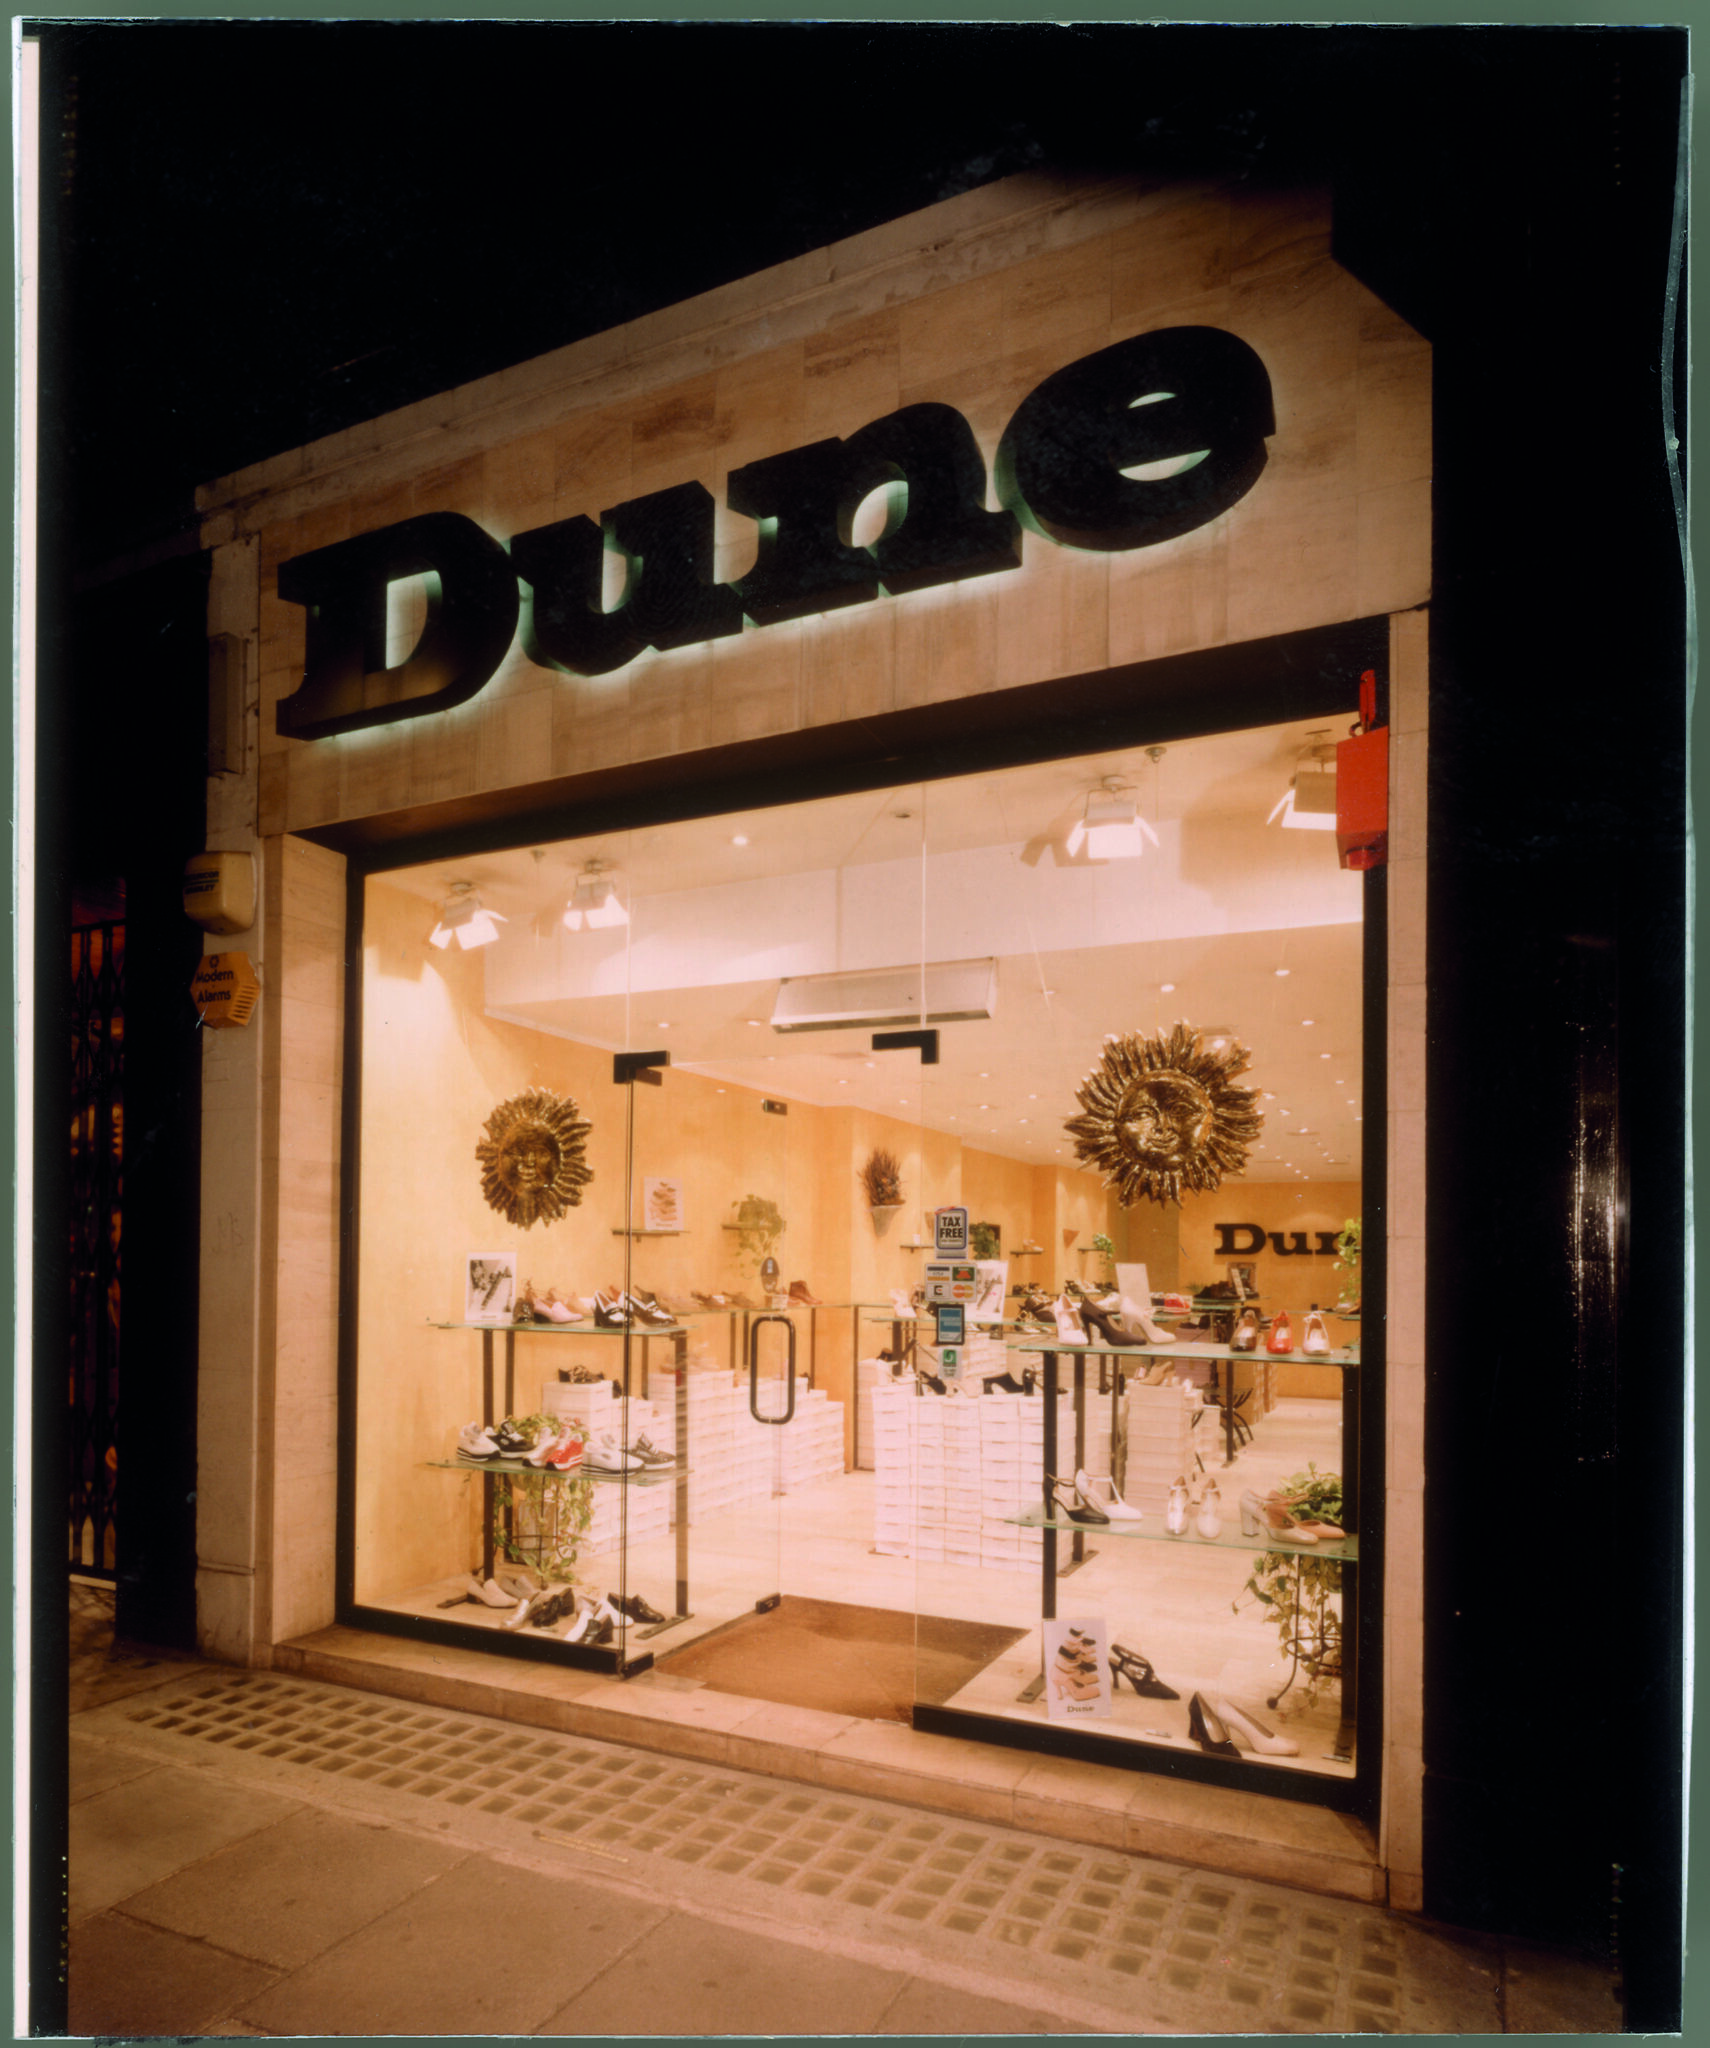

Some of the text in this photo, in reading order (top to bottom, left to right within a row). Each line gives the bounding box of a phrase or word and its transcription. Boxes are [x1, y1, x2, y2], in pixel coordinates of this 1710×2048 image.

[276, 324, 1276, 742] Dune
[195, 969, 234, 984] Modern
[197, 989, 232, 1003] Alarms
[942, 1216, 961, 1227] TAX
[940, 1228, 963, 1238] FREE
